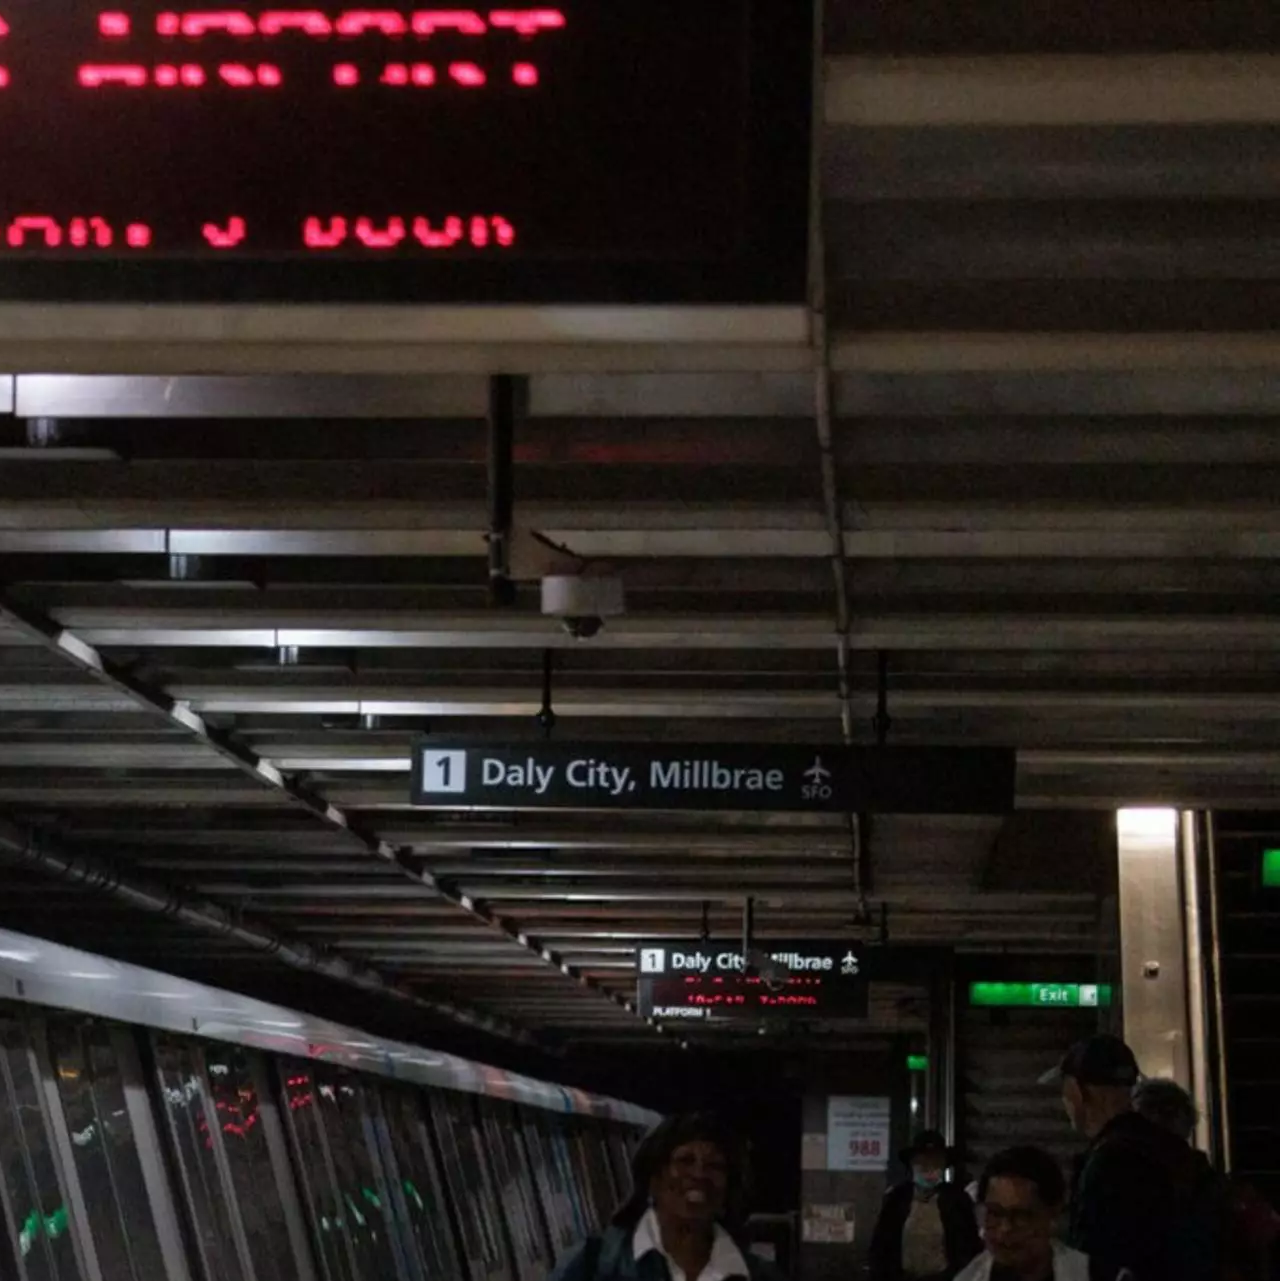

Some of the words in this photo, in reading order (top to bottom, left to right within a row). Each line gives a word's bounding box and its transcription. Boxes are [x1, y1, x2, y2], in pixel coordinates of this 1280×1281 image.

[436, 755, 450, 787] 1
[481, 757, 555, 794] Daly
[565, 758, 636, 795] City,
[649, 760, 784, 790] Millbrae
[802, 784, 832, 799] SFO
[672, 952, 711, 972] Daly
[1040, 987, 1068, 1002] Exit
[652, 1006, 703, 1017] PLATFORM
[705, 1006, 711, 1017] 1
[848, 1139, 881, 1157] 988
